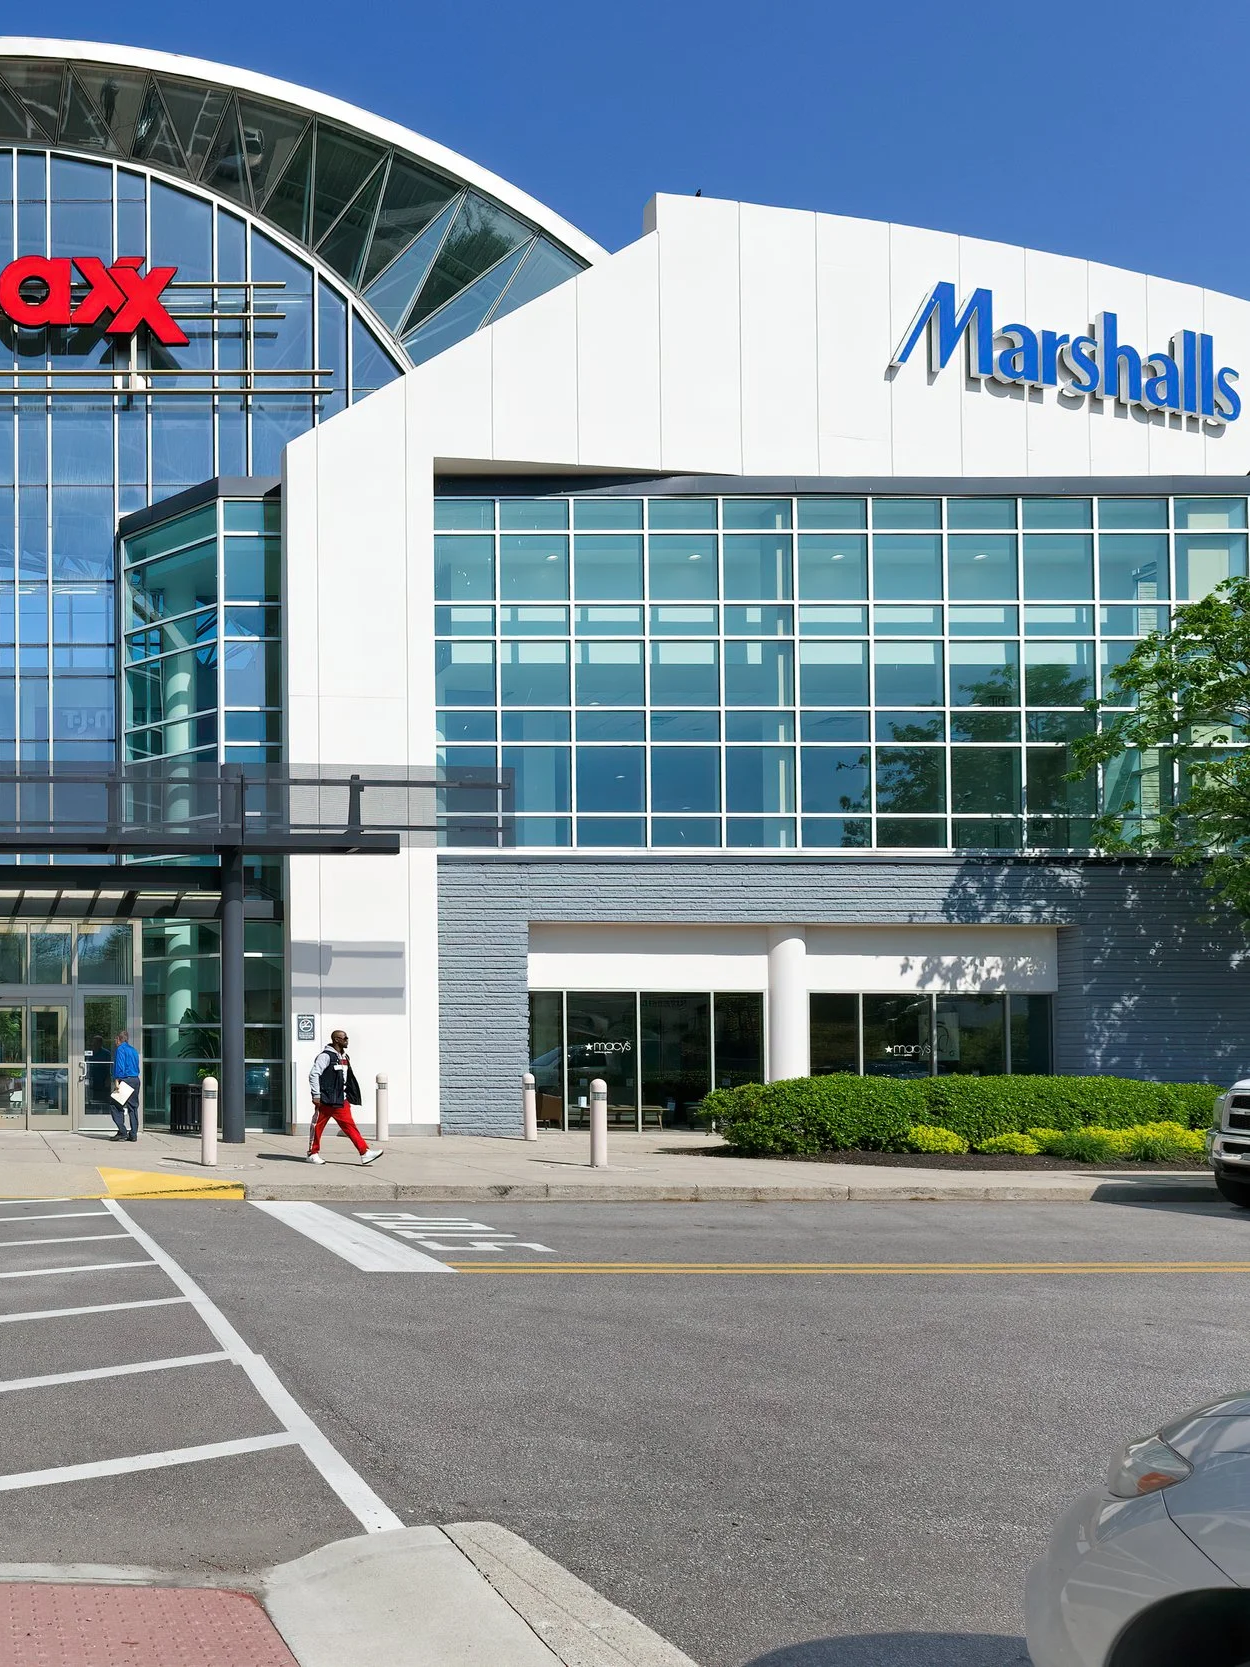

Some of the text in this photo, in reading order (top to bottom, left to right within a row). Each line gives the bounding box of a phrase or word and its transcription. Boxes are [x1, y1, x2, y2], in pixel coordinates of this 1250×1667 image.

[888, 281, 1242, 422] Marshalls
[593, 1041, 631, 1053] macy's
[351, 1212, 558, 1252] STOP
